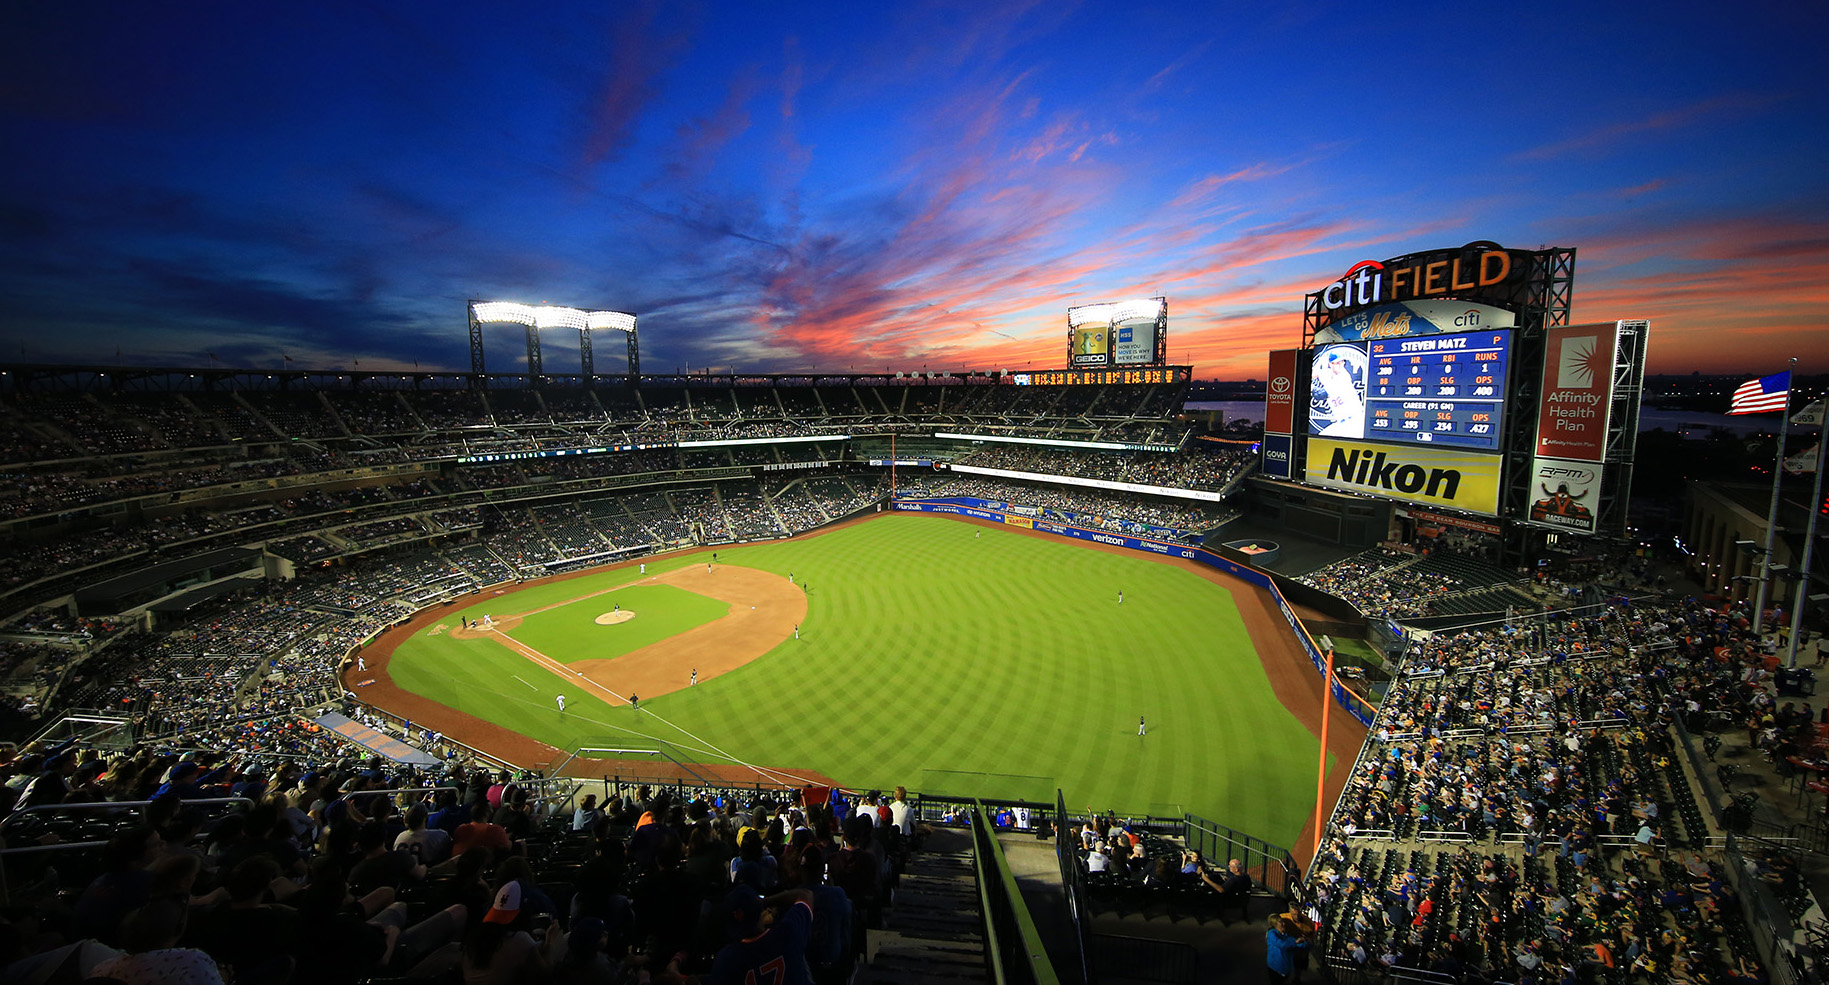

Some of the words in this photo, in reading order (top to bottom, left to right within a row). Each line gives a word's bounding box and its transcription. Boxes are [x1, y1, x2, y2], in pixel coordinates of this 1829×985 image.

[1323, 268, 1383, 310] citi
[1391, 250, 1511, 300] FIELD
[1341, 312, 1368, 328] LET'S
[1454, 311, 1480, 327] citi
[1355, 321, 1369, 331] GO
[1360, 312, 1412, 339] Mets
[1373, 345, 1384, 353] 32
[1400, 340, 1436, 352] STEVEN
[1437, 337, 1467, 350] MATZ
[1492, 336, 1502, 345] P
[1075, 354, 1105, 363] GEICO
[1474, 352, 1498, 361] RUNS
[1481, 363, 1489, 373] 1
[1440, 376, 1455, 384] SLG
[1475, 376, 1493, 384] OPS
[1547, 391, 1601, 406] Affinity
[1402, 402, 1427, 410] CAREER
[1549, 405, 1595, 418] Health
[1437, 412, 1452, 420] SLG
[1472, 413, 1489, 422] OPS
[1555, 418, 1585, 432] Plan
[1266, 450, 1287, 460] GOYA
[1326, 447, 1462, 500] Nikon
[1539, 466, 1583, 478] RPM
[1092, 533, 1124, 546] verizon
[1181, 550, 1195, 558] citi
